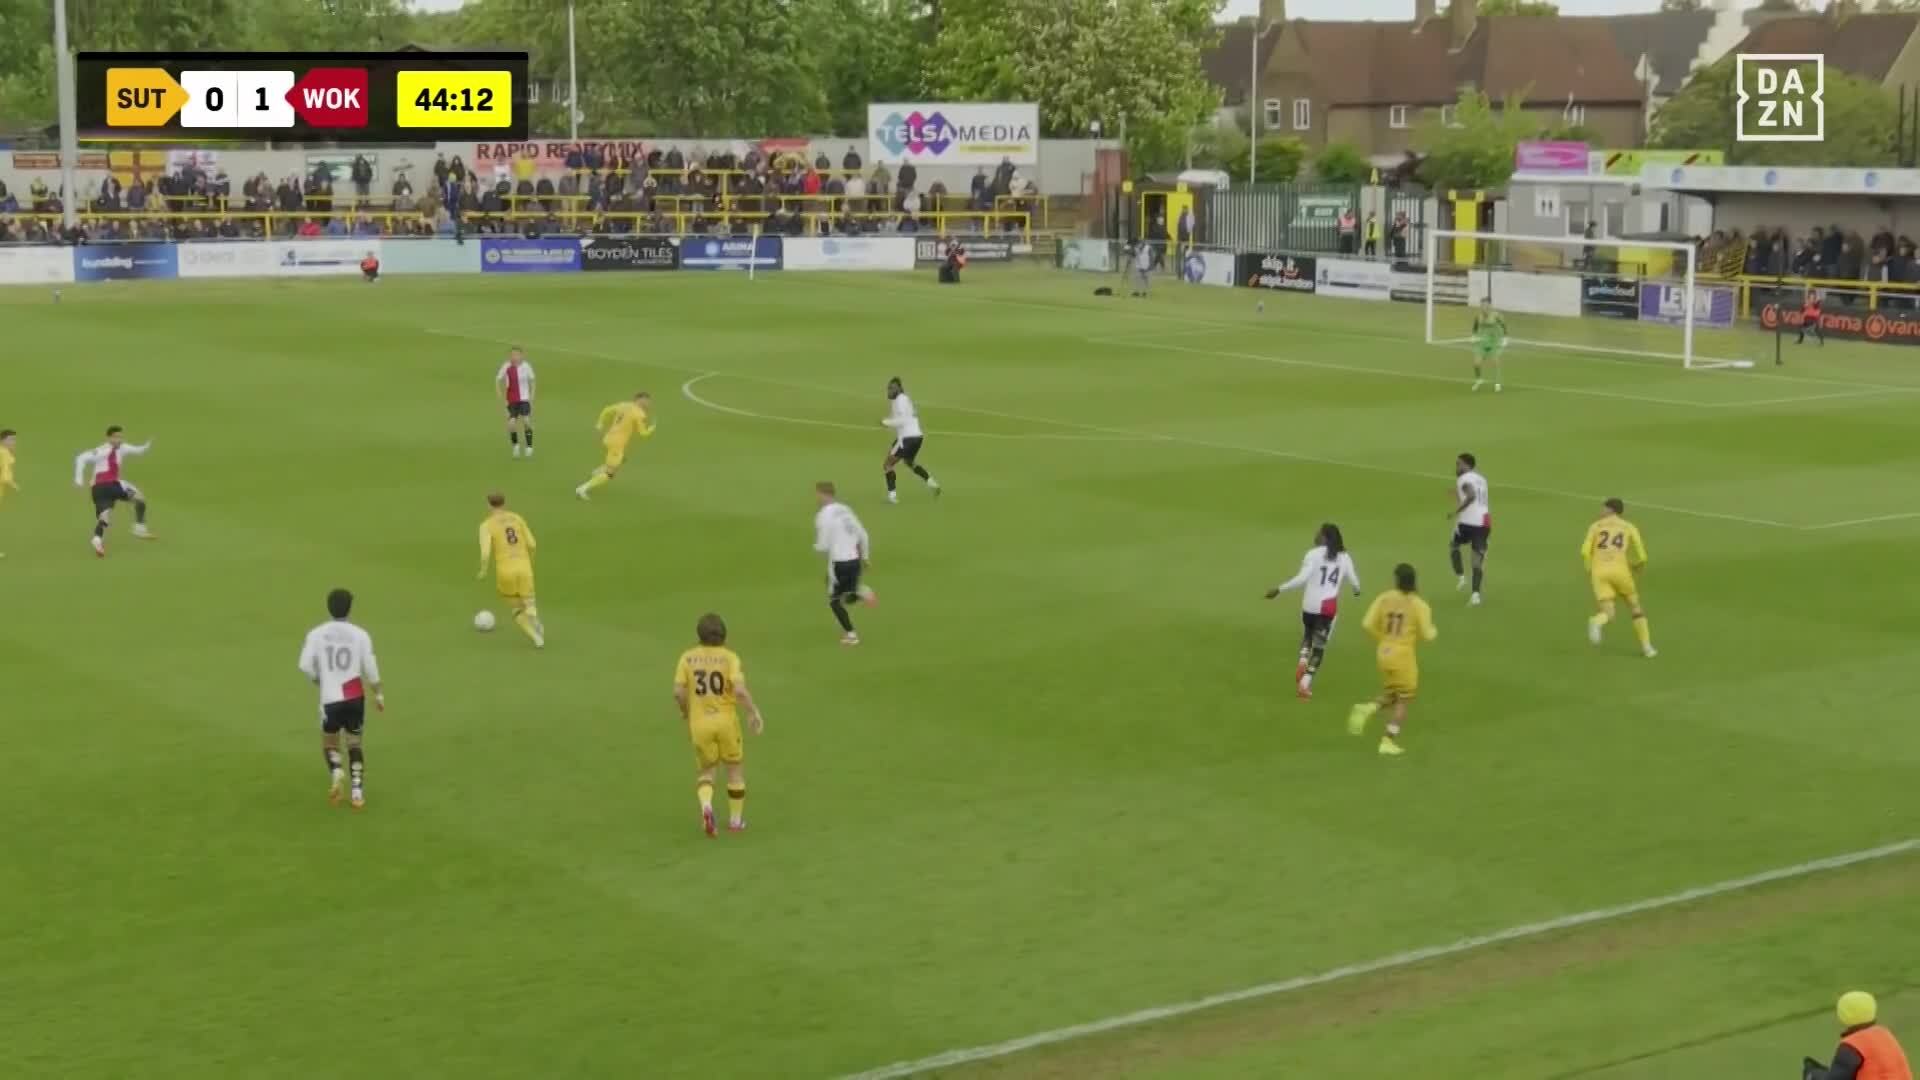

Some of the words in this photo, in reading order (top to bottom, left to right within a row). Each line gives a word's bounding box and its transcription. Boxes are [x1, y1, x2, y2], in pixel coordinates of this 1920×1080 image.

[477, 143, 539, 159] RAPID
[587, 248, 639, 259] BOYDEN
[643, 248, 673, 259] TILES
[1782, 311, 1863, 332] varama
[1887, 318, 1920, 336] van
[505, 527, 518, 545] 8
[1597, 530, 1624, 550] 24
[1319, 565, 1340, 587] 14
[1387, 611, 1403, 636] 11
[325, 645, 352, 672] 10
[693, 669, 724, 696] 30
